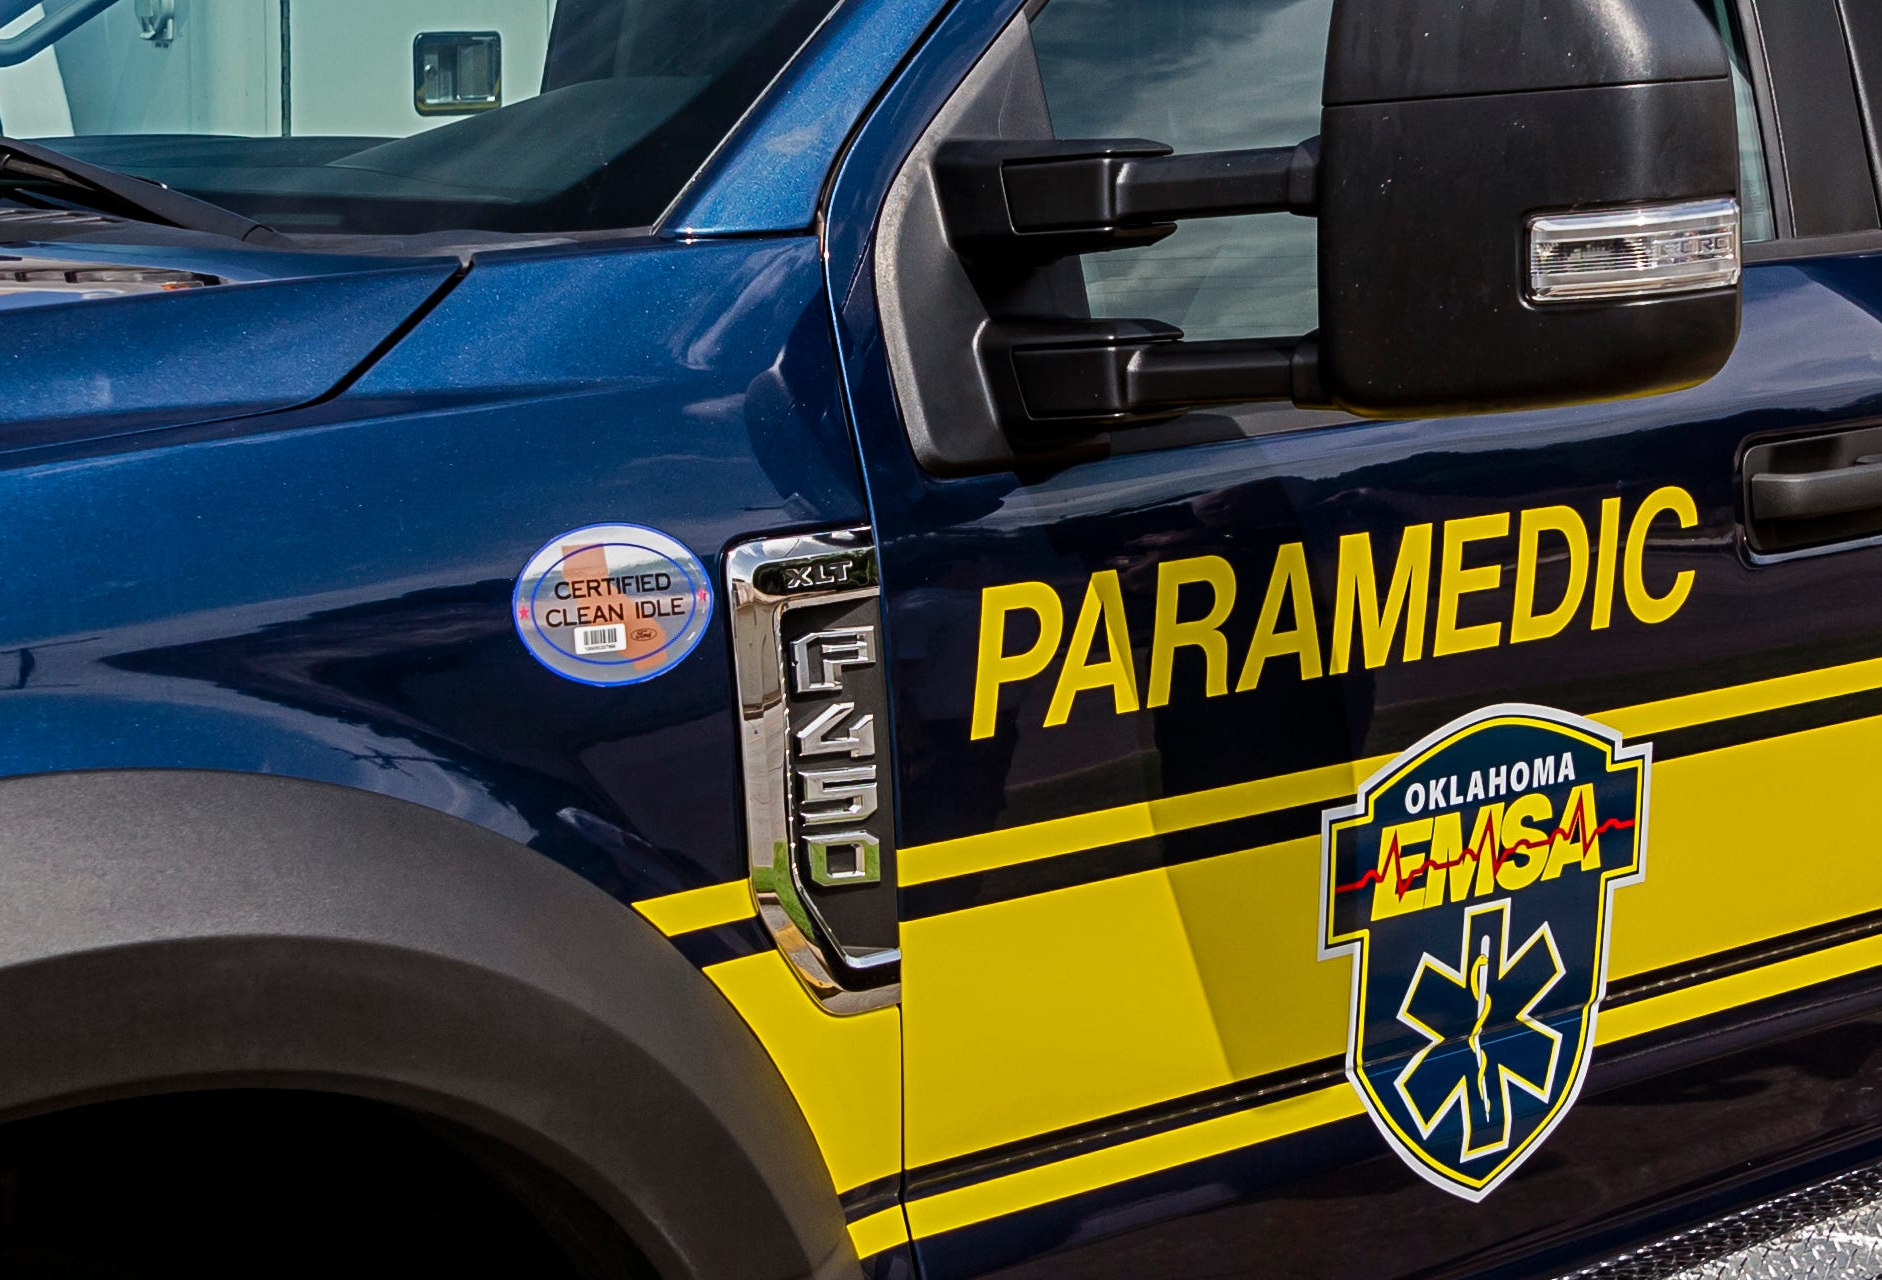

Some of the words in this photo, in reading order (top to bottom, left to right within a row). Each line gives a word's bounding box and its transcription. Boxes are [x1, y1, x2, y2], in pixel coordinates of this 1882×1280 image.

[554, 572, 672, 601] CERTIFIED
[787, 560, 853, 589] XLT
[545, 603, 625, 628] CLEAN
[634, 597, 686, 619] IDLE
[971, 486, 1698, 741] PARAMEDIC
[1404, 752, 1577, 815] OKLAHOMA
[1371, 783, 1601, 922] EMSA
